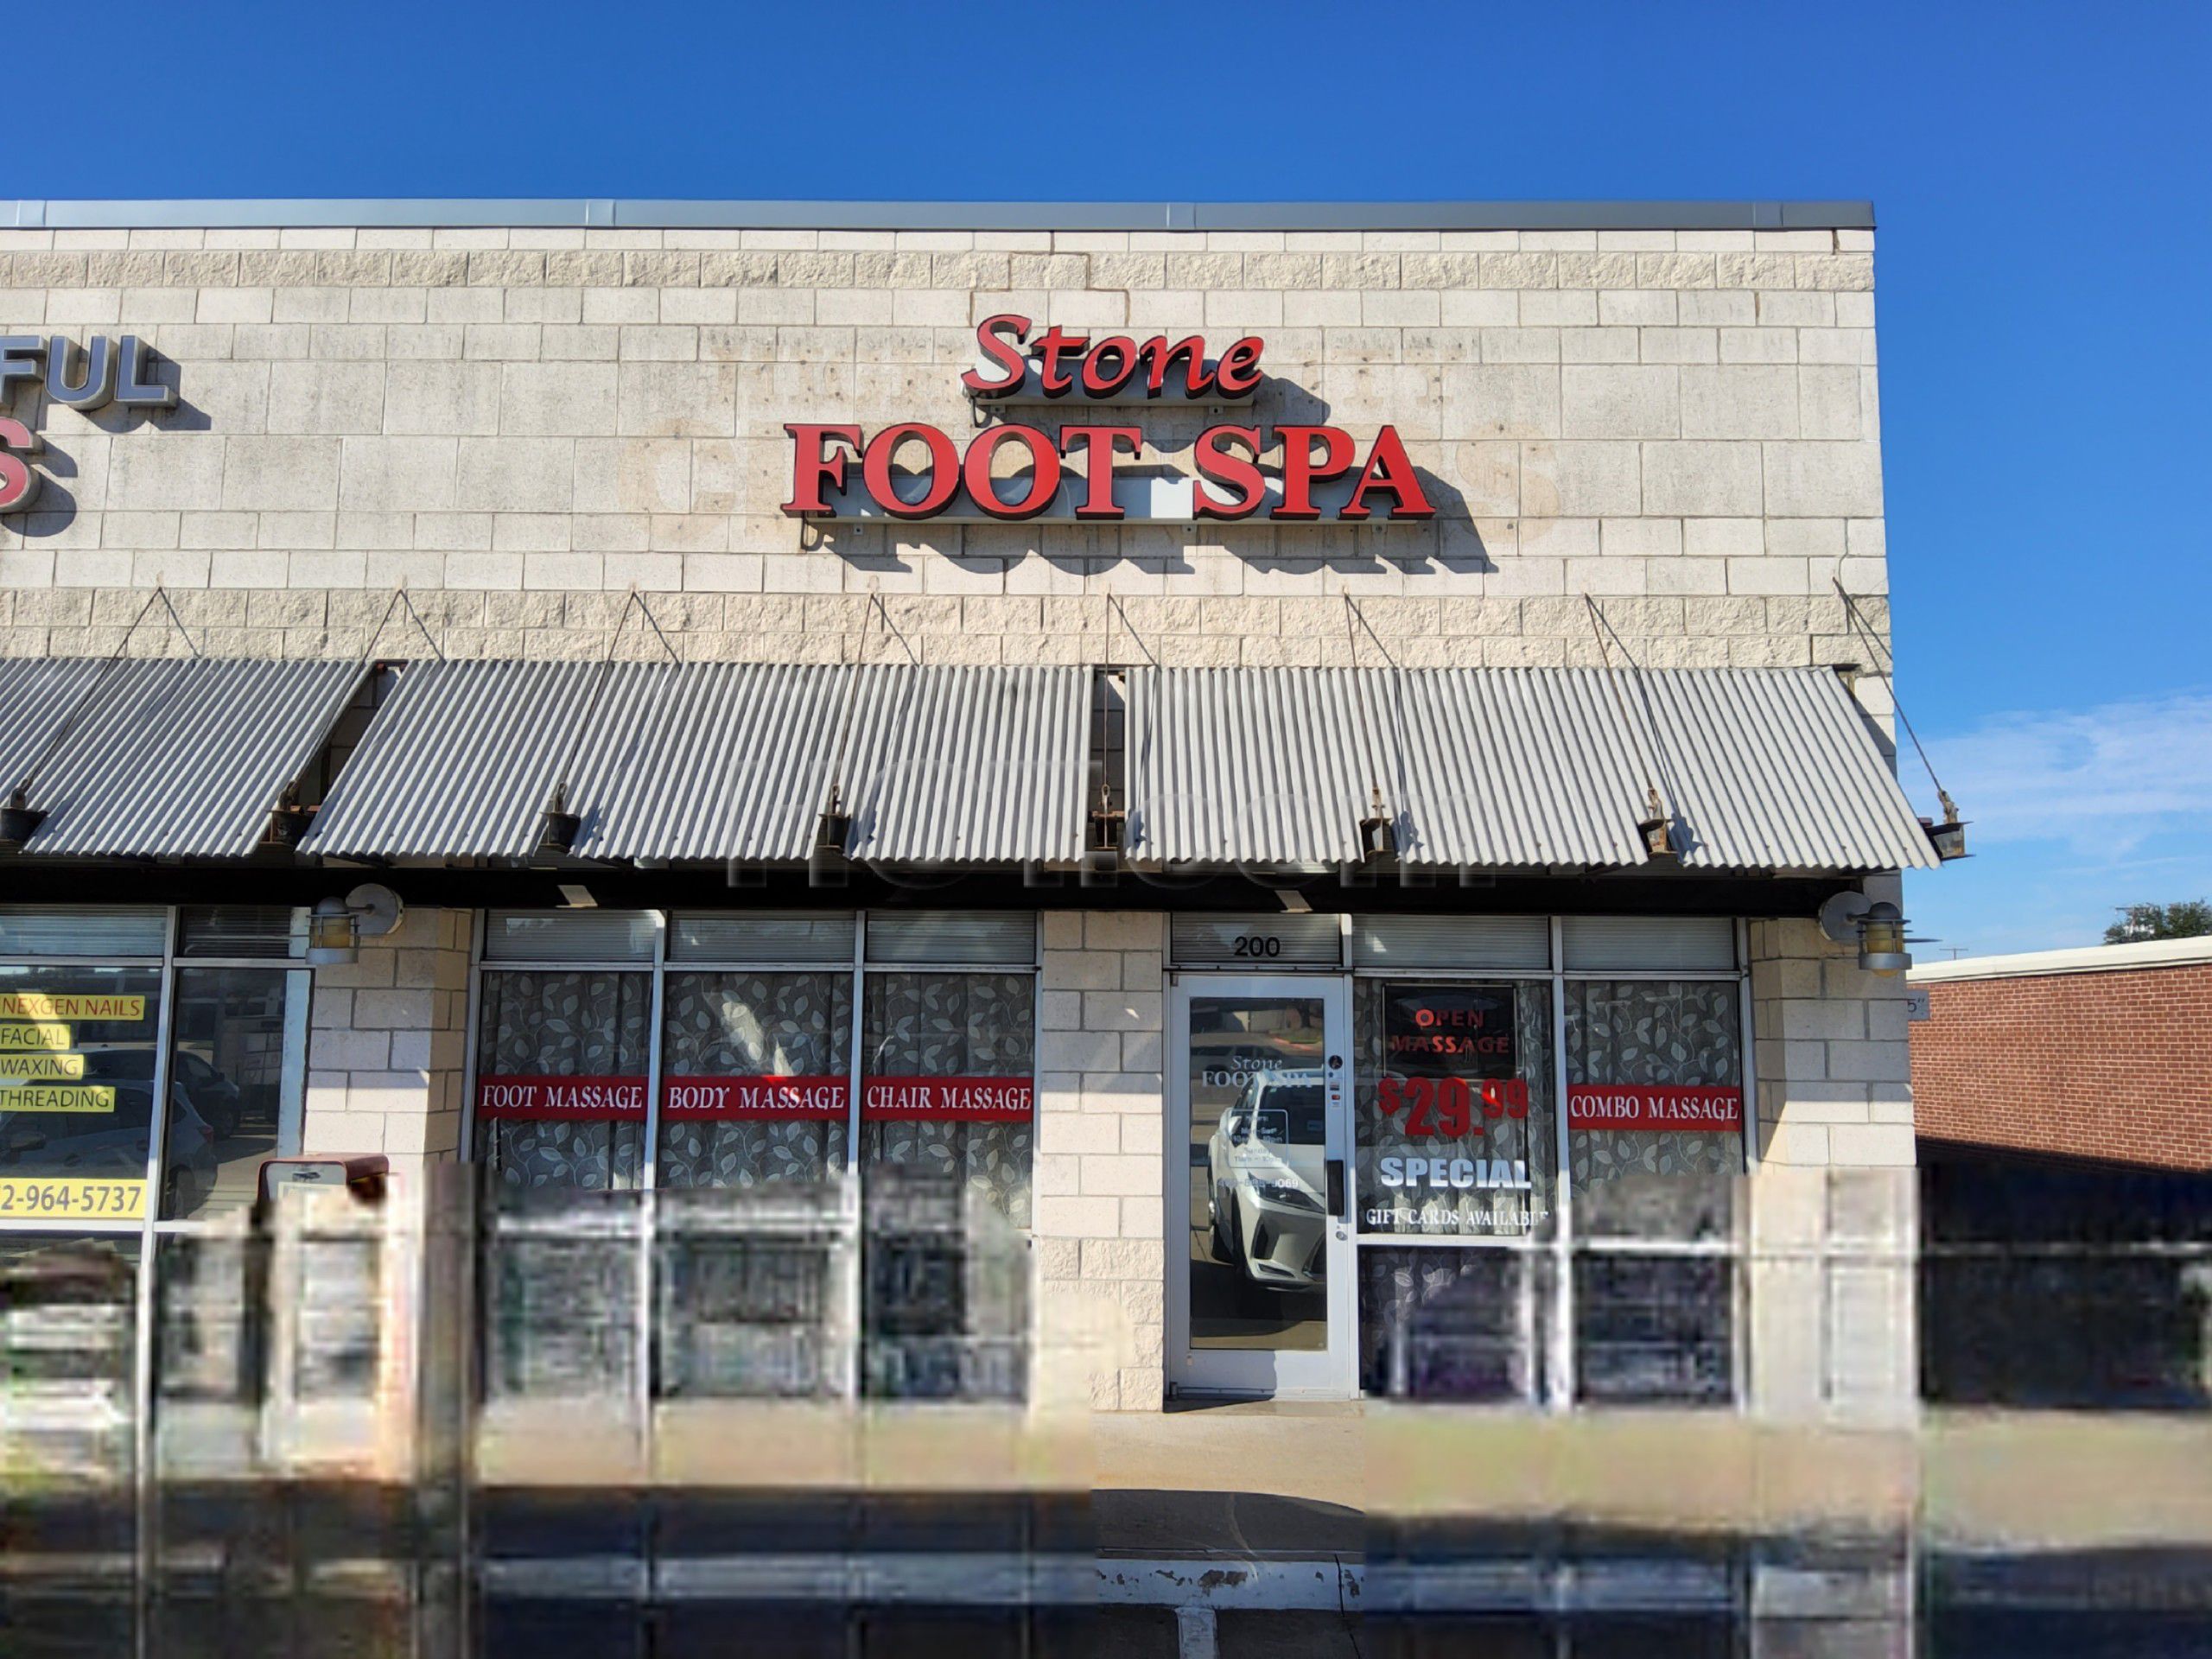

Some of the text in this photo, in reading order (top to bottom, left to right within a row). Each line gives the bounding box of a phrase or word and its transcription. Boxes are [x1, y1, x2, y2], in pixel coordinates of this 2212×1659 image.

[961, 314, 1264, 400] Stone
[780, 422, 1144, 520] FOOT
[1192, 424, 1438, 520] SPA
[1233, 936, 1281, 957] 200
[3, 997, 140, 1016] NEXGEN NAILS
[1415, 1009, 1484, 1027] OPEN
[1, 1027, 66, 1046] FACIAL
[1391, 1037, 1510, 1054] MASSAGE
[0, 1058, 79, 1076] WAXING
[1230, 1055, 1283, 1071] Stone
[0, 1090, 110, 1107] THREADING
[482, 1085, 643, 1109] FOOT MASSAGE
[668, 1086, 844, 1110] BODY MASSAGE
[867, 1086, 1032, 1111] CHAIR MASSAGE
[1378, 1077, 1529, 1138] $29.99
[1570, 1096, 1738, 1122] COMBO MASSAGE
[1381, 1157, 1532, 1190] SPECIAL
[1366, 1209, 1401, 1225] GIFT
[1408, 1209, 1459, 1225] CARDS
